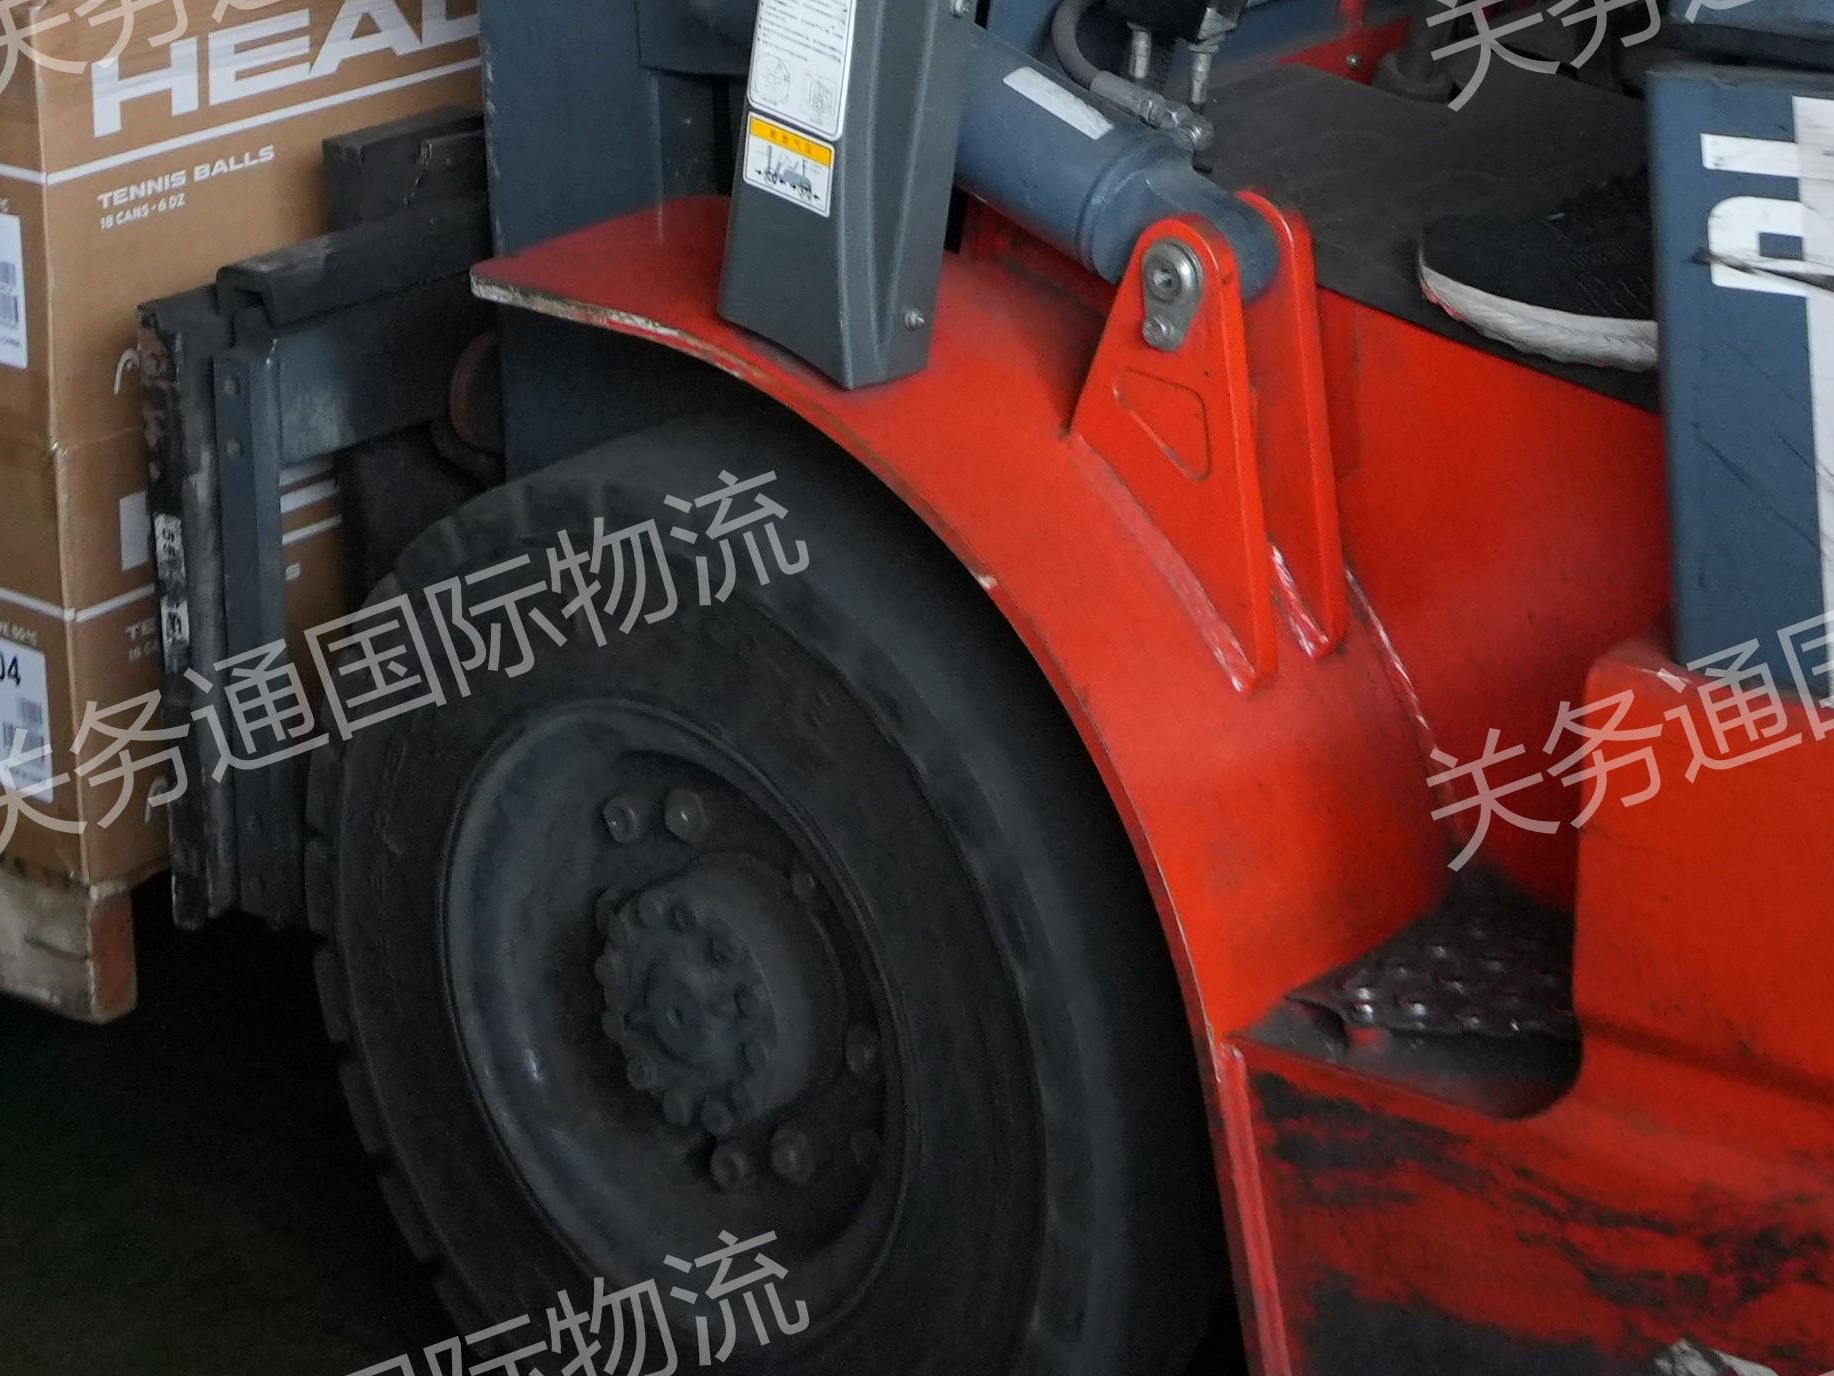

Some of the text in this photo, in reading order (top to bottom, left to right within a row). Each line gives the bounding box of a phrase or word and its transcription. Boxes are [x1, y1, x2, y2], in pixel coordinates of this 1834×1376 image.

[98, 145, 275, 208] TENNIS BALLS
[100, 193, 185, 230] 18 CANS 6 DZ
